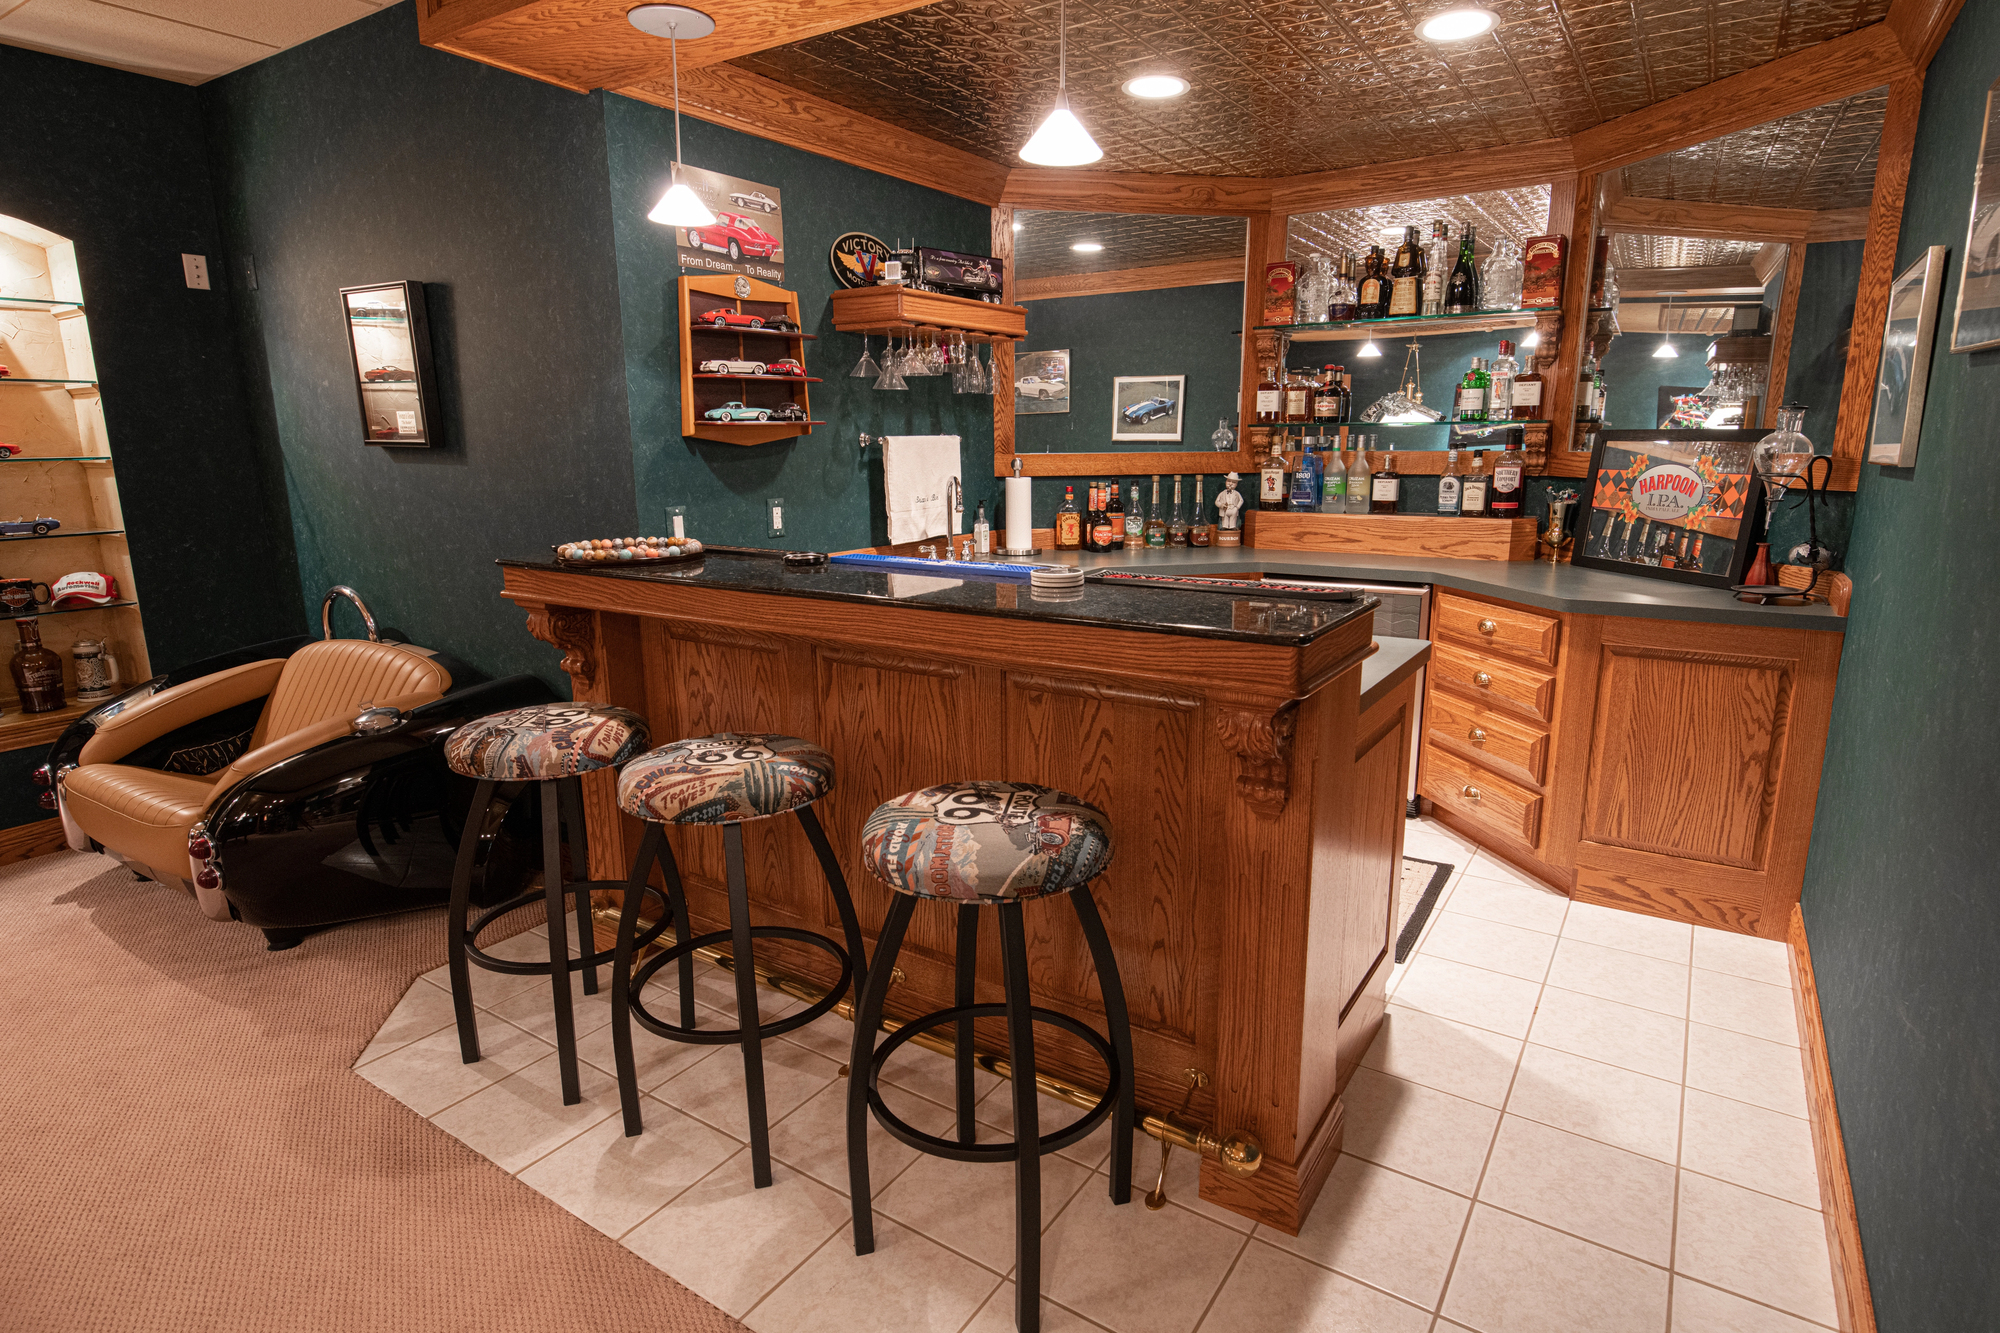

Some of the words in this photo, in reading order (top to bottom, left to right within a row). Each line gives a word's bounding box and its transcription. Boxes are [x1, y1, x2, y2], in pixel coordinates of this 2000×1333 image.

[842, 238, 890, 260] VICTORY
[681, 254, 703, 267] From
[705, 258, 741, 273] Dream...
[745, 264, 755, 275] To
[757, 266, 782, 281] Reality
[1496, 469, 1519, 477] SOUTHERN
[1638, 474, 1699, 498] HARPOON
[1646, 493, 1684, 509] I.P.A.
[57, 584, 99, 593] Automation
[597, 724, 615, 752] TRAILS
[611, 723, 627, 747] WEST
[695, 747, 764, 764] 66
[634, 765, 712, 790] CHICAGO
[777, 763, 819, 778] ROAD
[660, 780, 707, 811] TRAILS
[678, 782, 717, 812] WEST
[943, 792, 1003, 820] 66
[1010, 794, 1034, 821] ROUTE
[890, 820, 910, 854] ROAD
